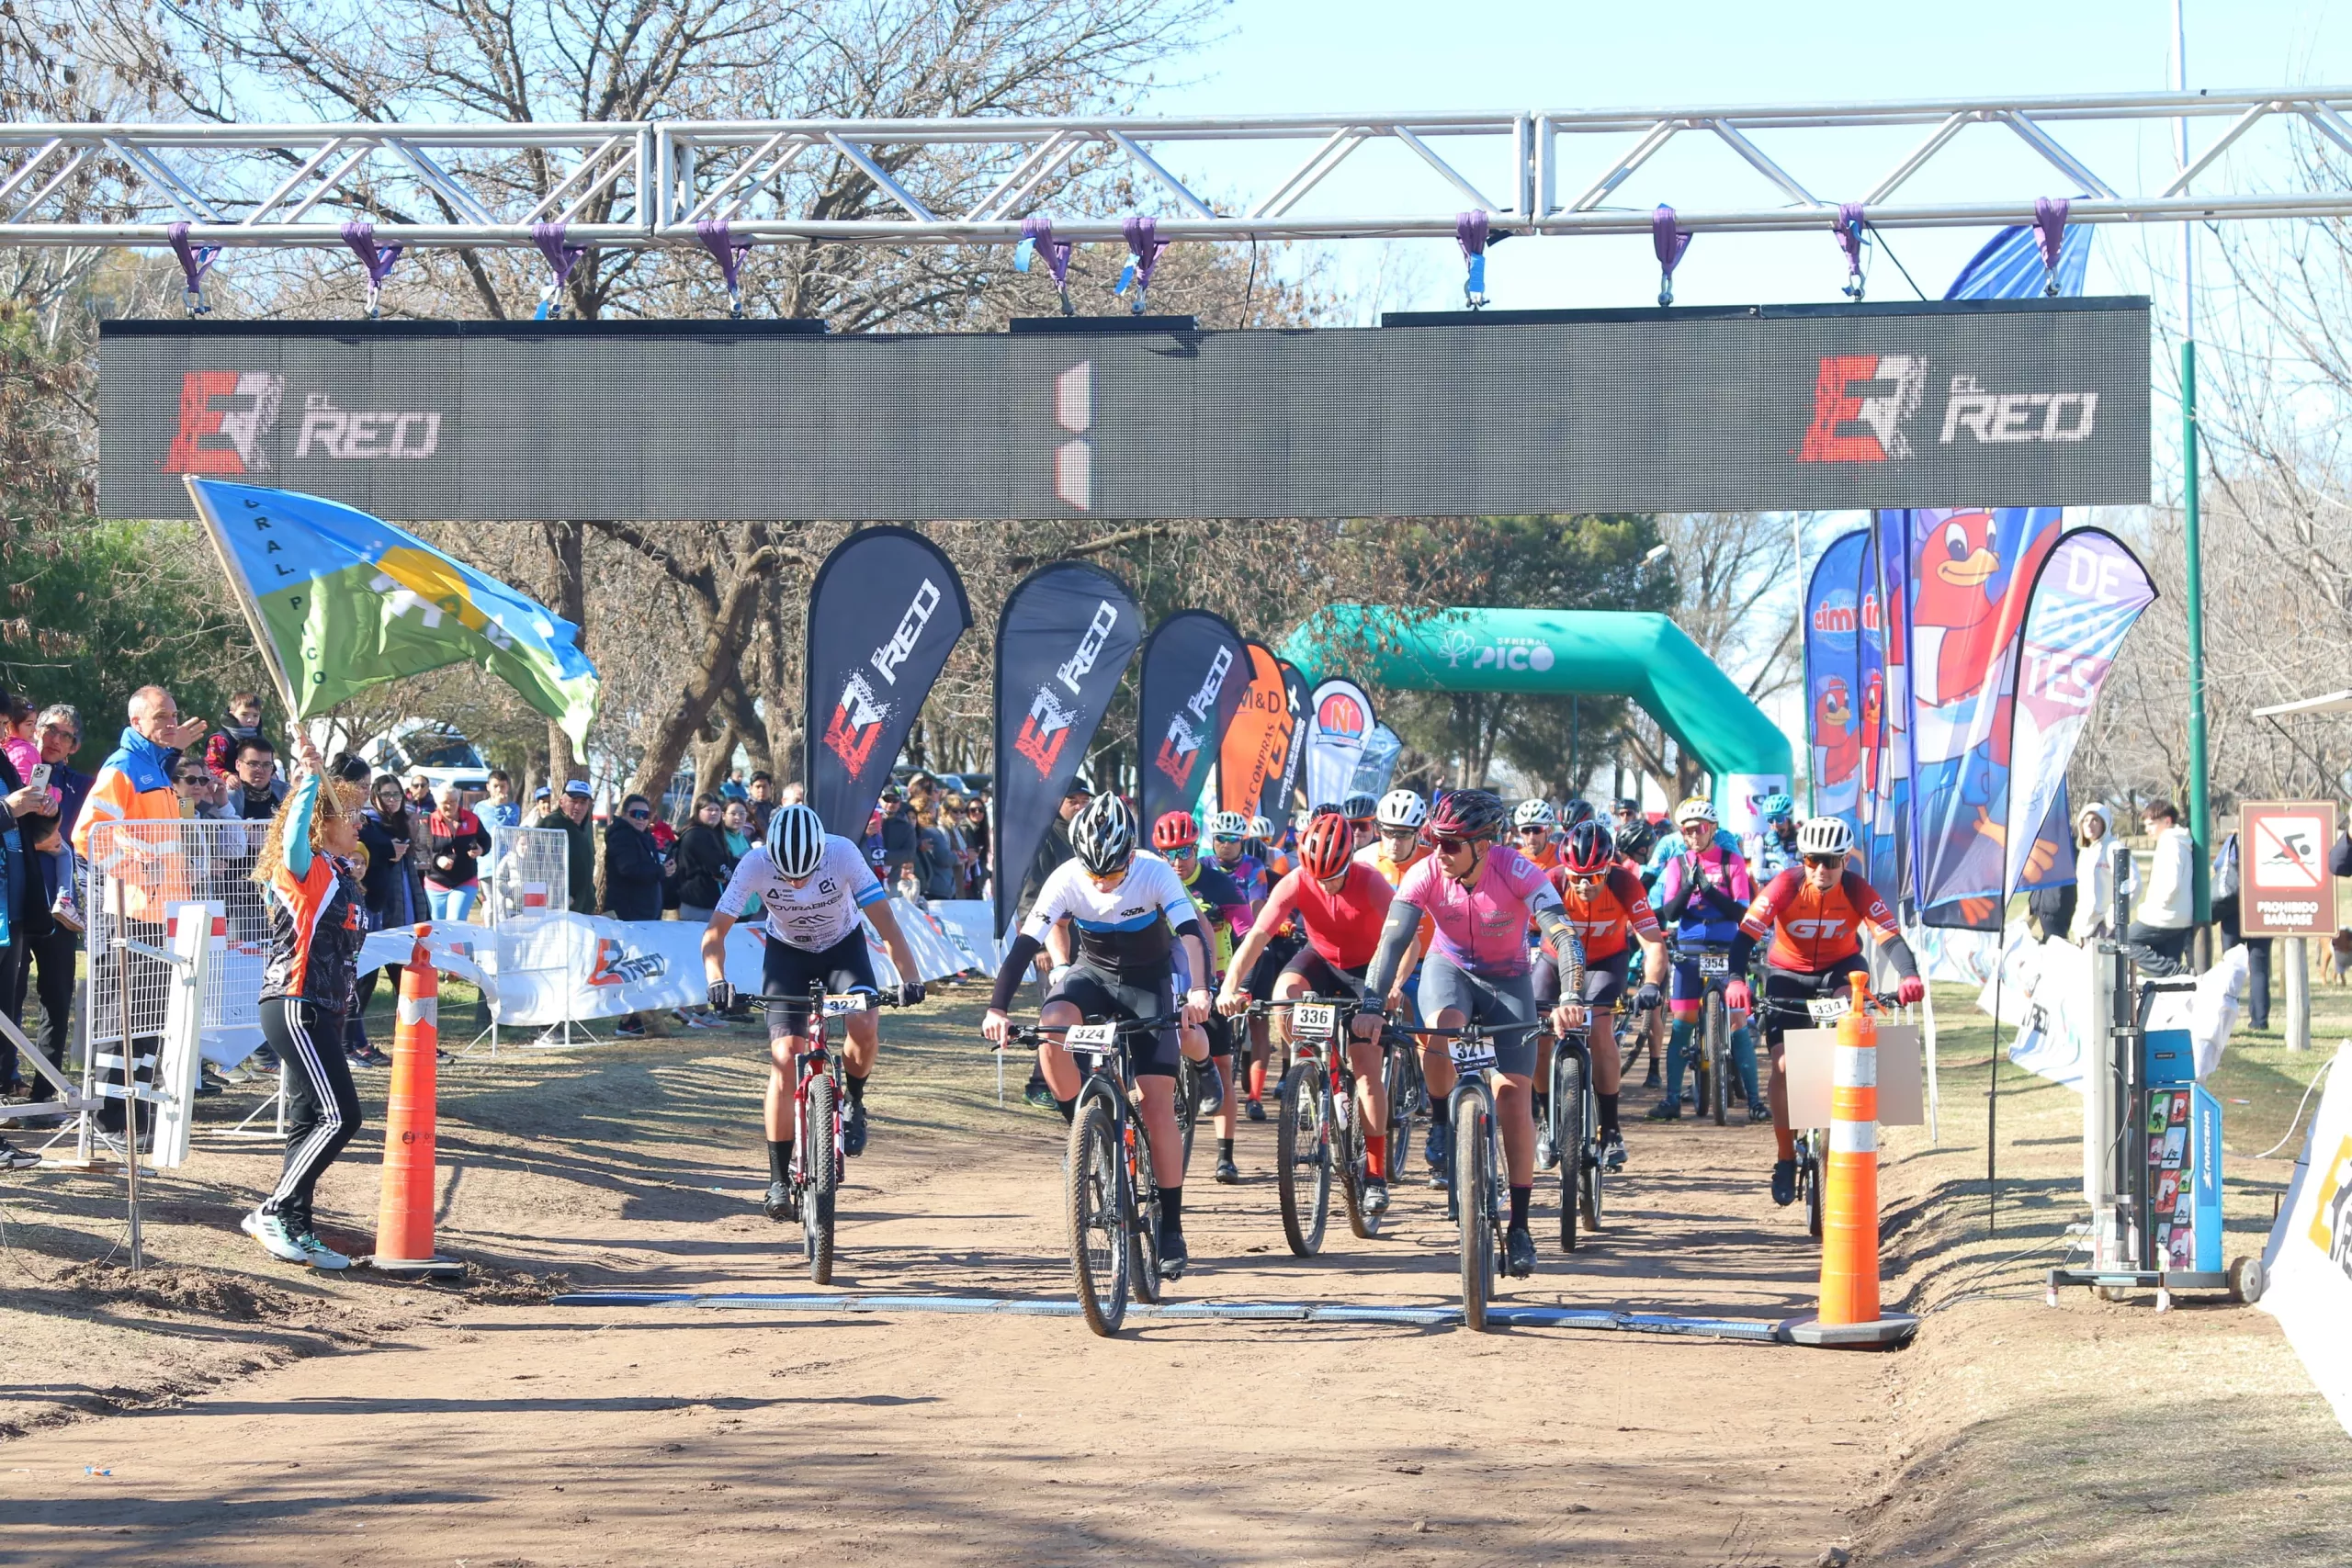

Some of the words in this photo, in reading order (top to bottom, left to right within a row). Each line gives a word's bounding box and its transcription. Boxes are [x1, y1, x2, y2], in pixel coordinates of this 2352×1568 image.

[2067, 546, 2128, 604] DE
[1473, 646, 1555, 671] PICO
[2023, 646, 2096, 708] TES
[1241, 796, 1254, 820] DE
[1250, 724, 1275, 795] COMPRAS
[1278, 777, 1289, 809] CENTRO
[2256, 901, 2319, 913] PROHIBIDO
[2263, 912, 2313, 925] BAÑARSE
[1704, 958, 1724, 968] 354
[830, 999, 858, 1010] 322
[1815, 1001, 1841, 1014] 334
[1300, 1010, 1329, 1024] 336
[1075, 1029, 1106, 1040] 324
[2203, 1110, 2211, 1170] MACSHA
